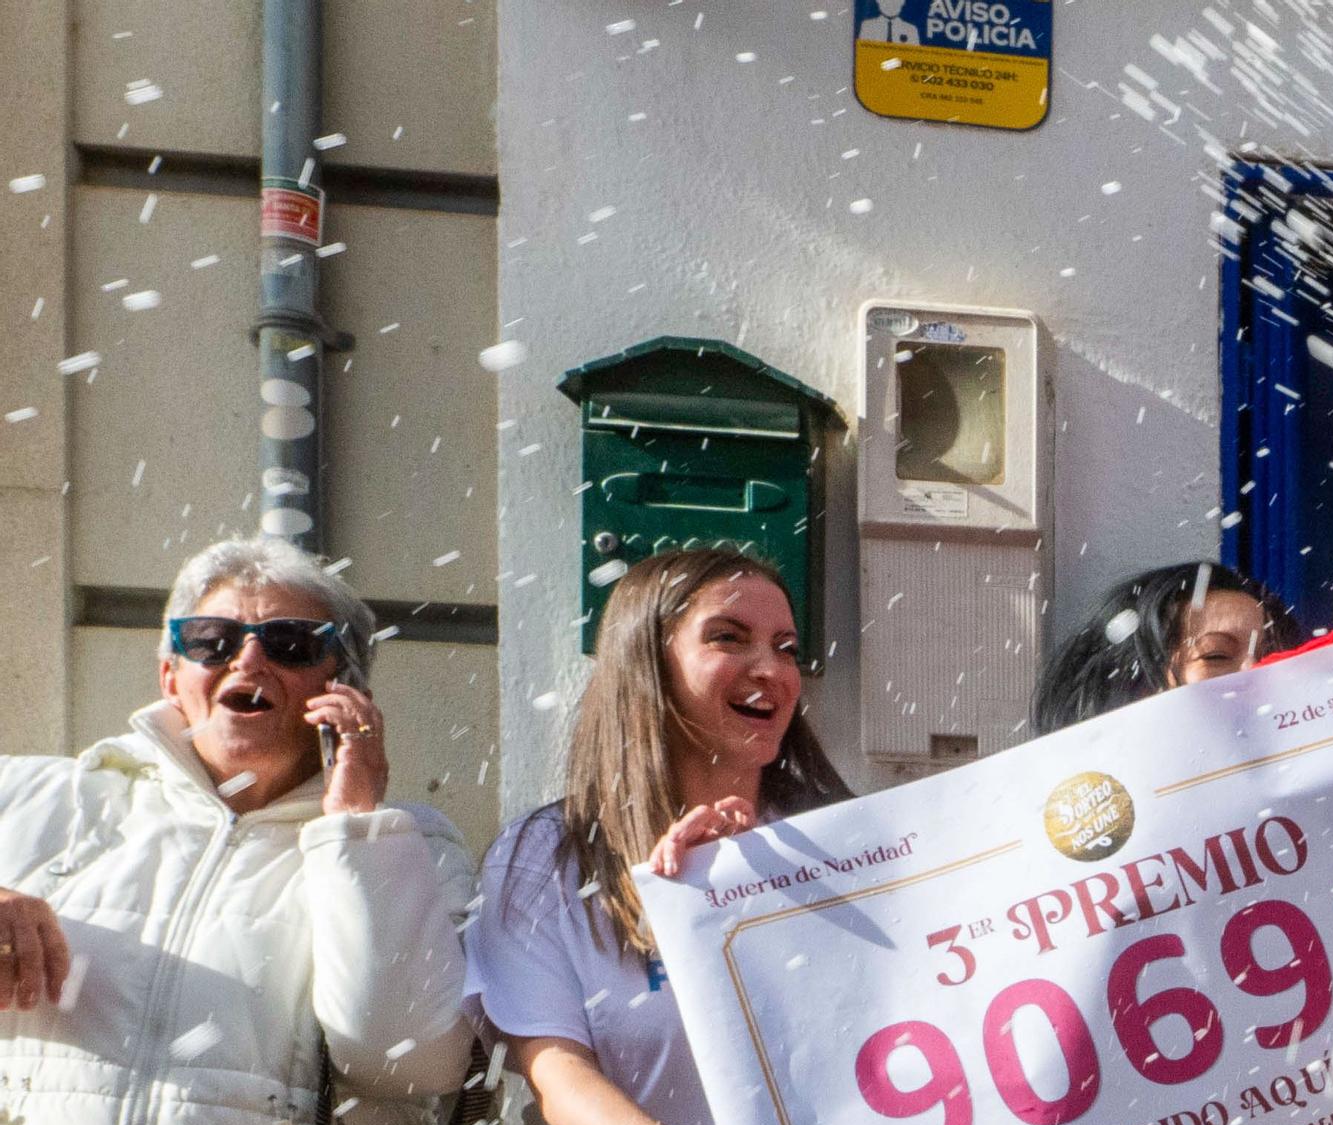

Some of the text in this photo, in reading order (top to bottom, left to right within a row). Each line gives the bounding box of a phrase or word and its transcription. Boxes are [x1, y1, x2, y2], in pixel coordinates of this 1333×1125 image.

[927, 0, 1010, 25] AVISO
[1273, 710, 1299, 730] 22
[1302, 704, 1325, 722] de
[705, 832, 918, 909] Lotería de Navidad
[1006, 815, 1309, 956] PREMIO
